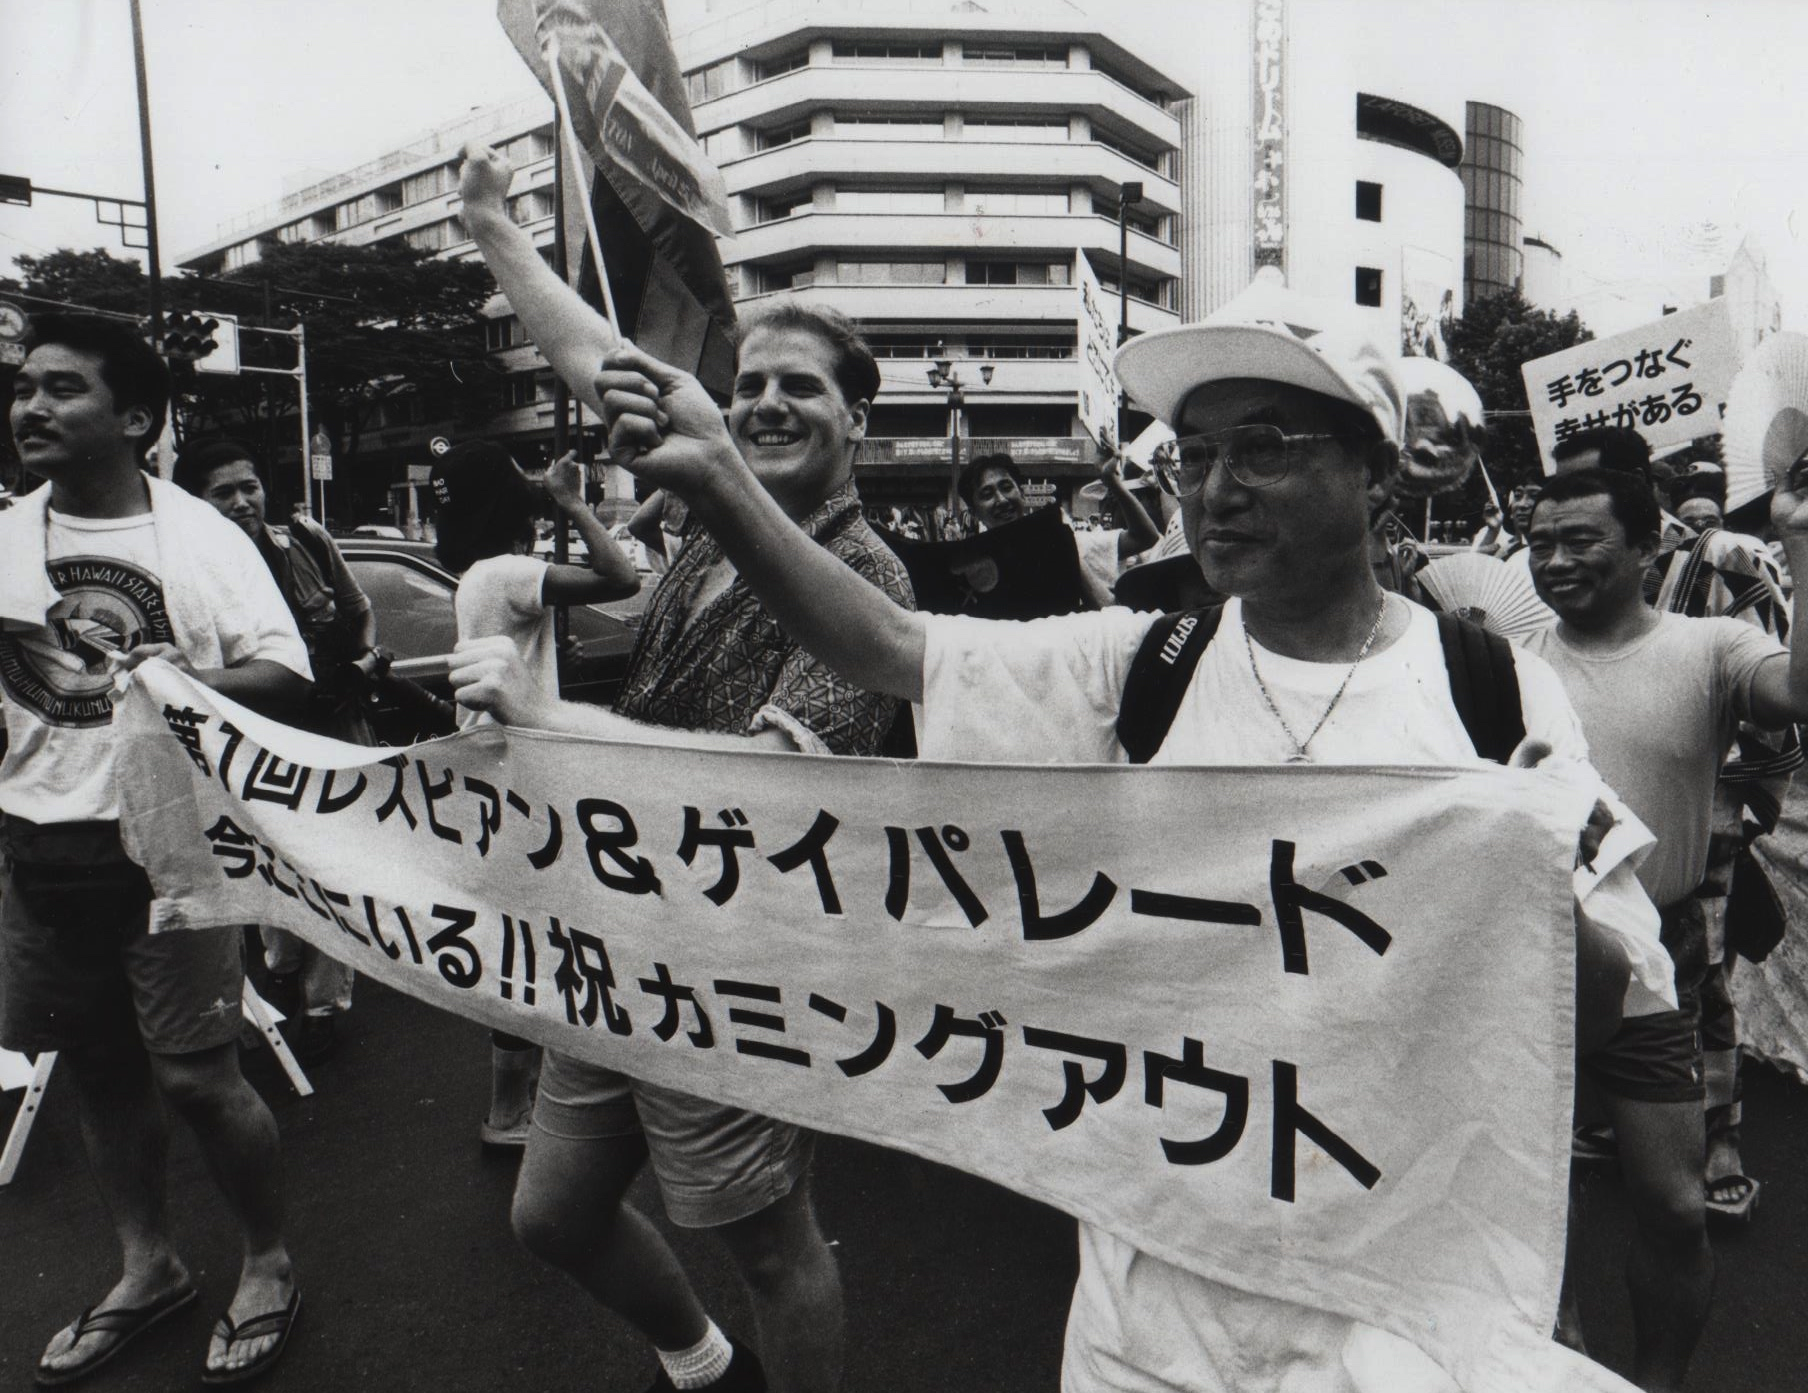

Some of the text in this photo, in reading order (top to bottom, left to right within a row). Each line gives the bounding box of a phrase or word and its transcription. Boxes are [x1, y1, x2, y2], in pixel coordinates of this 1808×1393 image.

[1546, 338, 1693, 408] 手をつなぐ
[1554, 382, 1703, 443] 幸せがある
[70, 566, 127, 586] HAWAII
[123, 577, 161, 610] STATE
[149, 608, 171, 640] FISH
